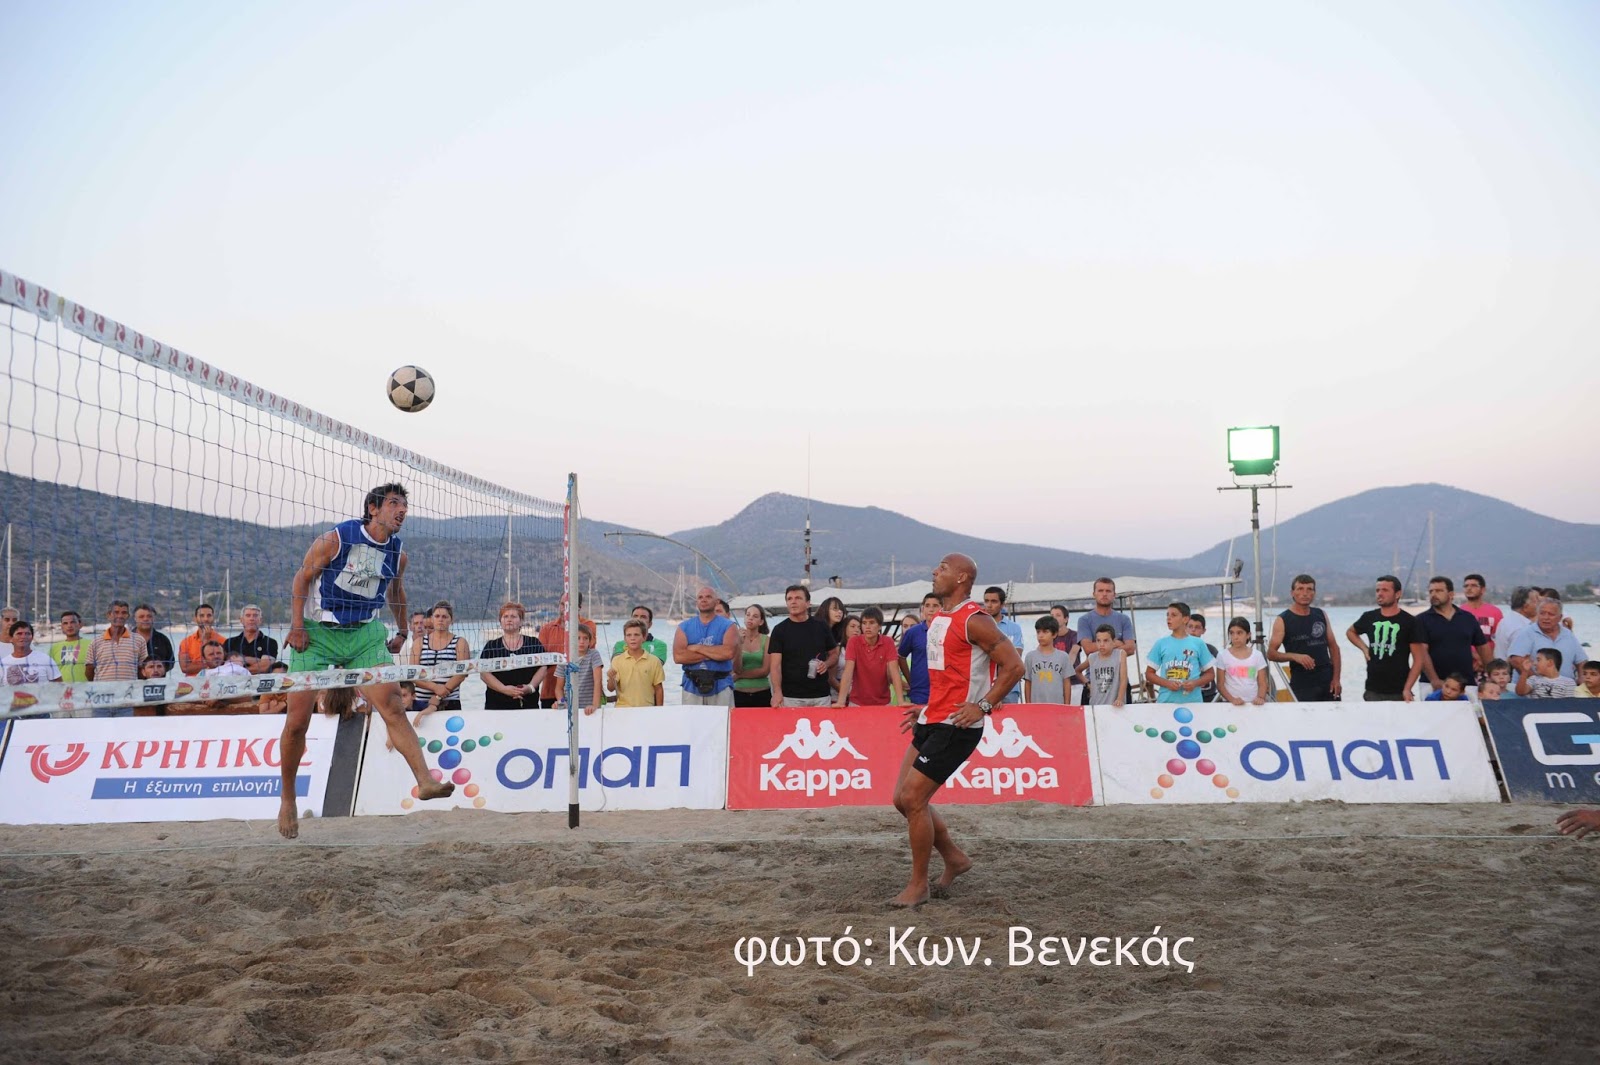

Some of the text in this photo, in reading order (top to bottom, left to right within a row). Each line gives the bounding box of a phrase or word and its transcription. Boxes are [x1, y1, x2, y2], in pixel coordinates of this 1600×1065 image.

[1522, 712, 1600, 765] G
[145, 780, 202, 796] έξυπνη
[212, 779, 279, 794] επιλογή!
[759, 763, 872, 796] Kappa
[945, 760, 1059, 795] Kappa
